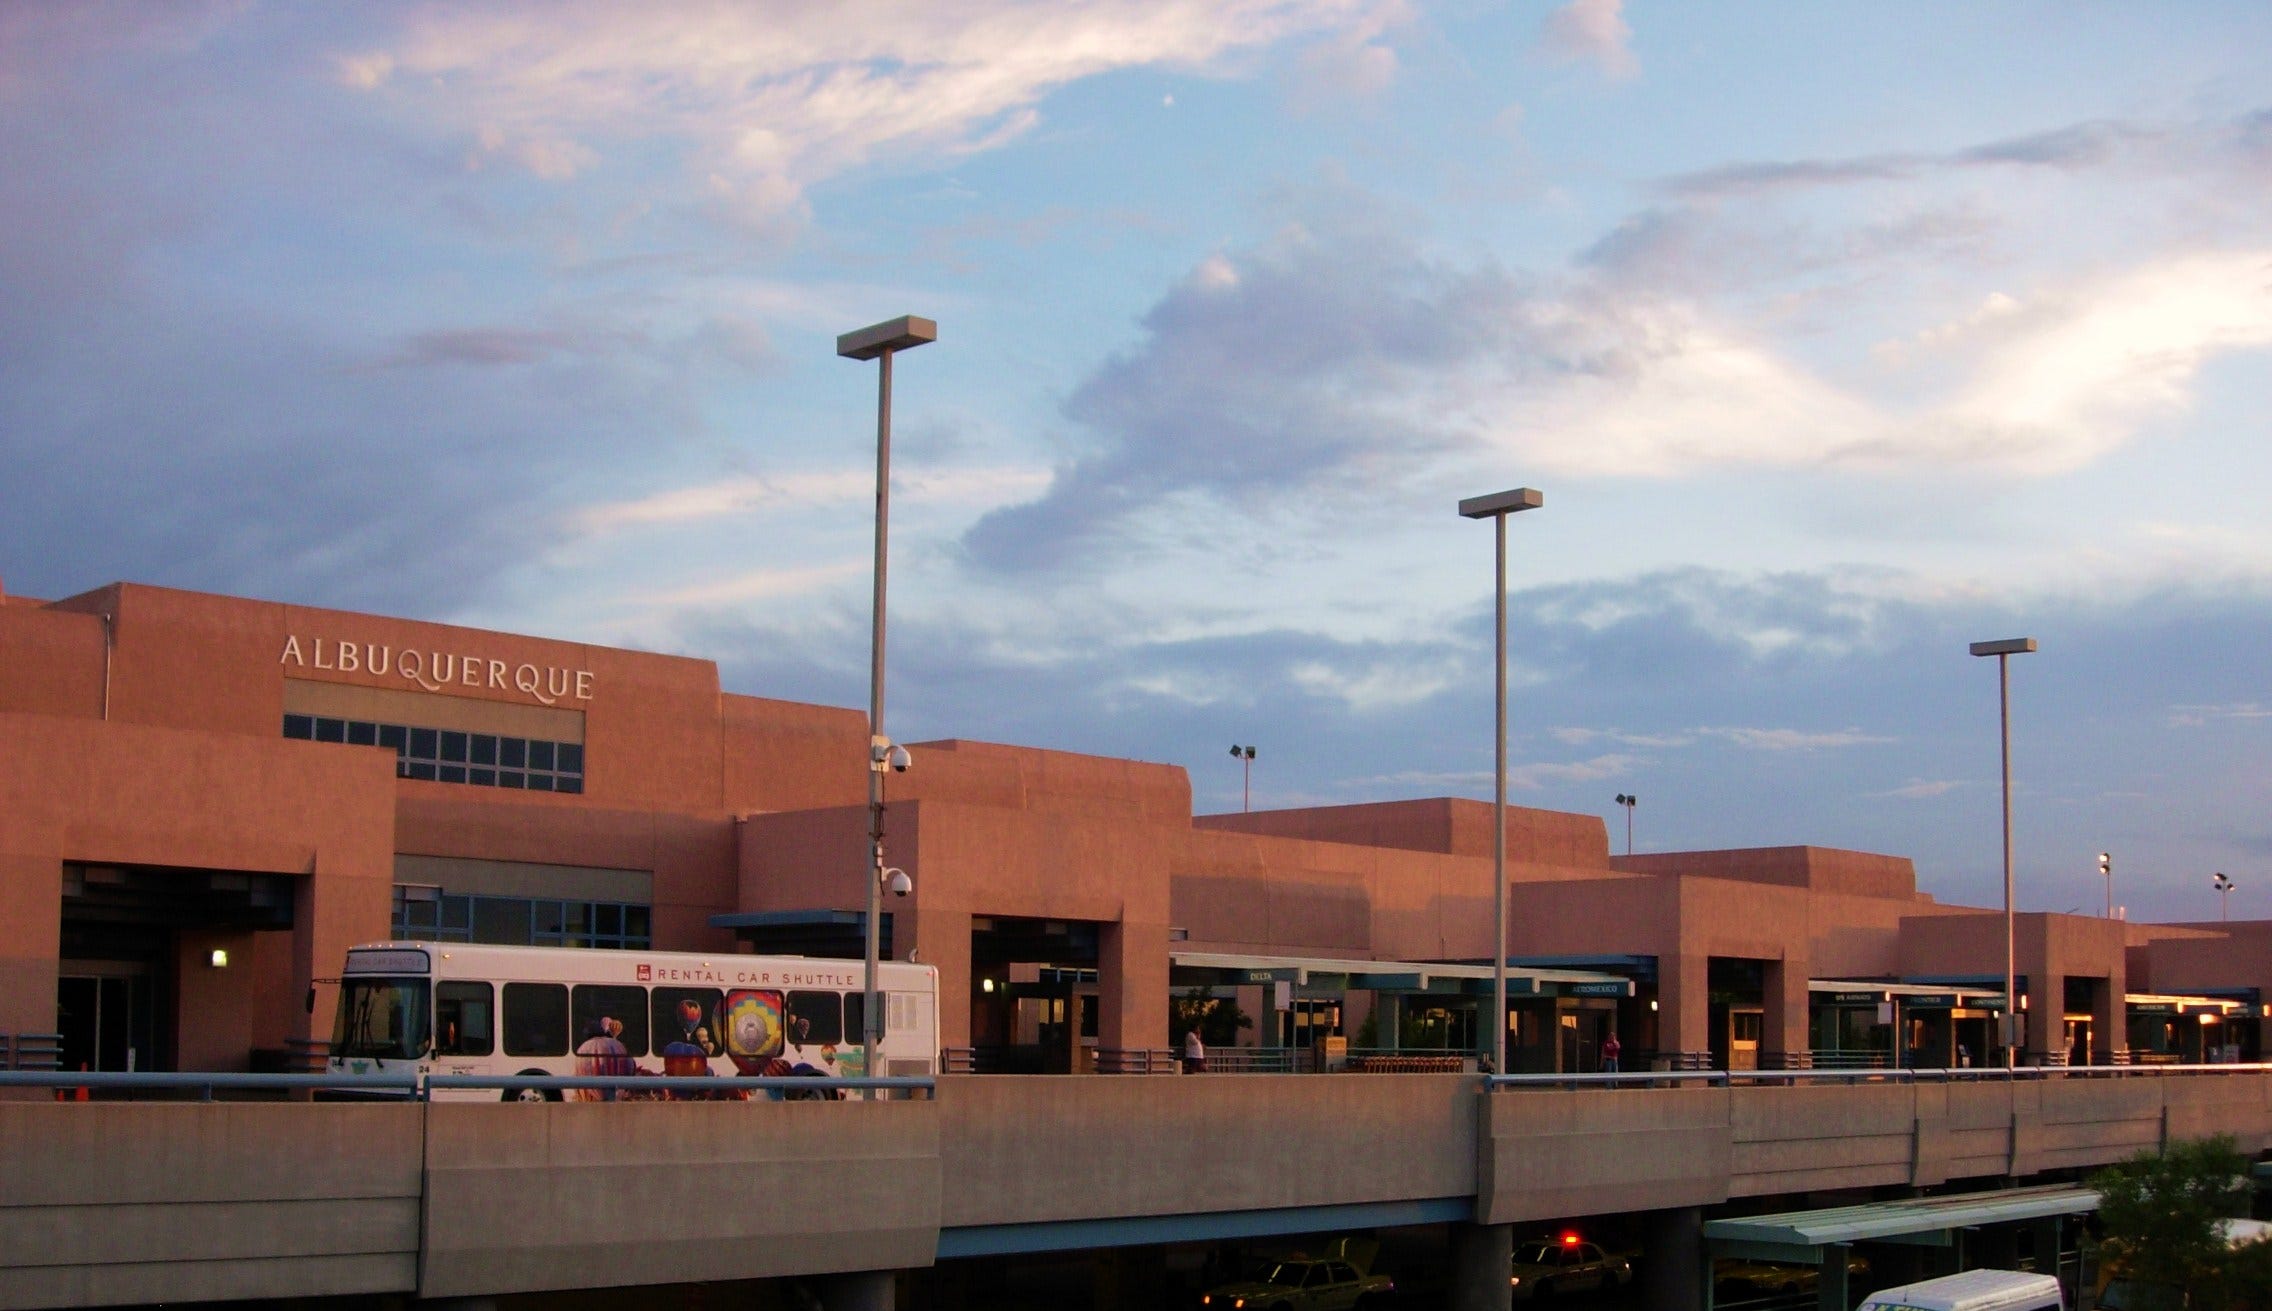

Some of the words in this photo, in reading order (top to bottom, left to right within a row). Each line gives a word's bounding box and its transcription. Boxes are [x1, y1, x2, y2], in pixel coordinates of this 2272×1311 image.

[279, 634, 596, 705] ALBUQUERQUE
[658, 968, 725, 982] RENTAL
[737, 971, 771, 984] CAR
[782, 973, 855, 986] SHUTTLE
[1250, 972, 1272, 981] DELTA
[418, 1065, 430, 1074] 24
